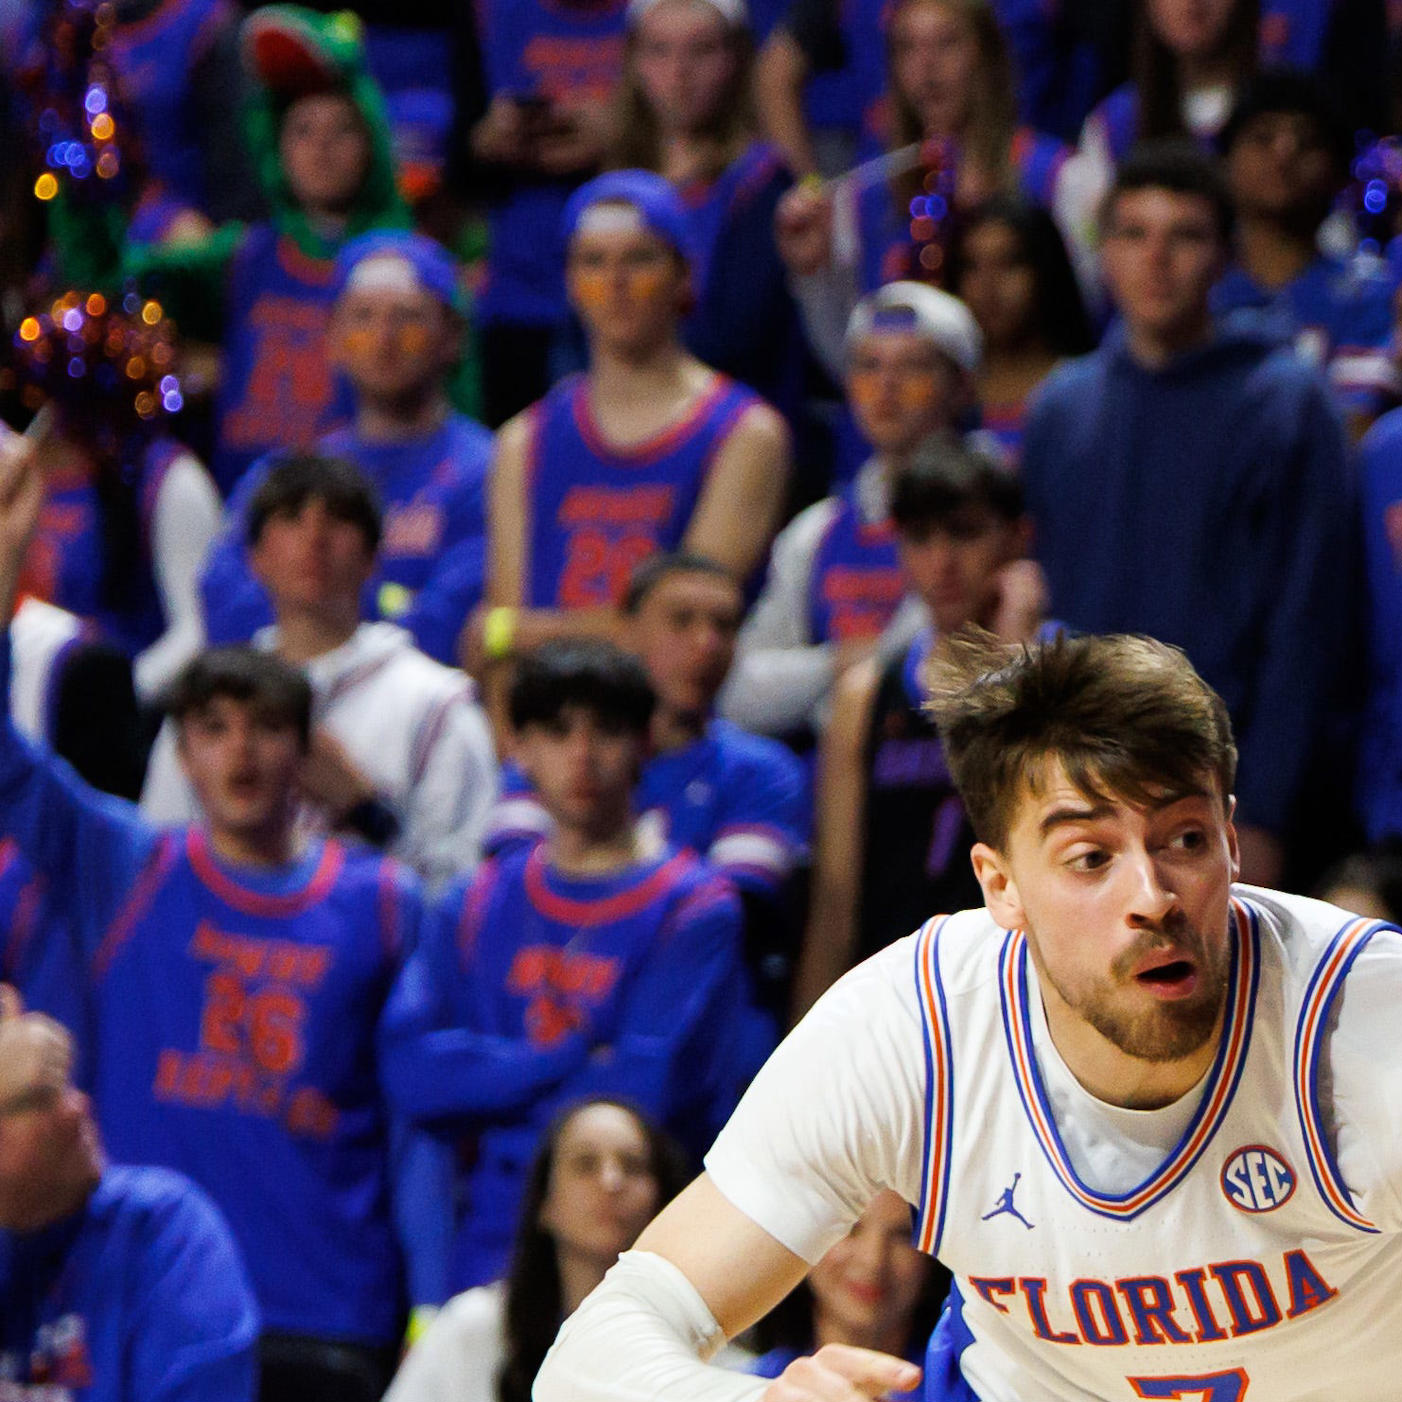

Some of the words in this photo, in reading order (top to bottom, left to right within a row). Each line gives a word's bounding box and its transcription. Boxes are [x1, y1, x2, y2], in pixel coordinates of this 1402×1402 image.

[202, 972, 305, 1073] 26
[1227, 1151, 1290, 1209] SEC
[969, 1248, 1339, 1346] FLORIDA
